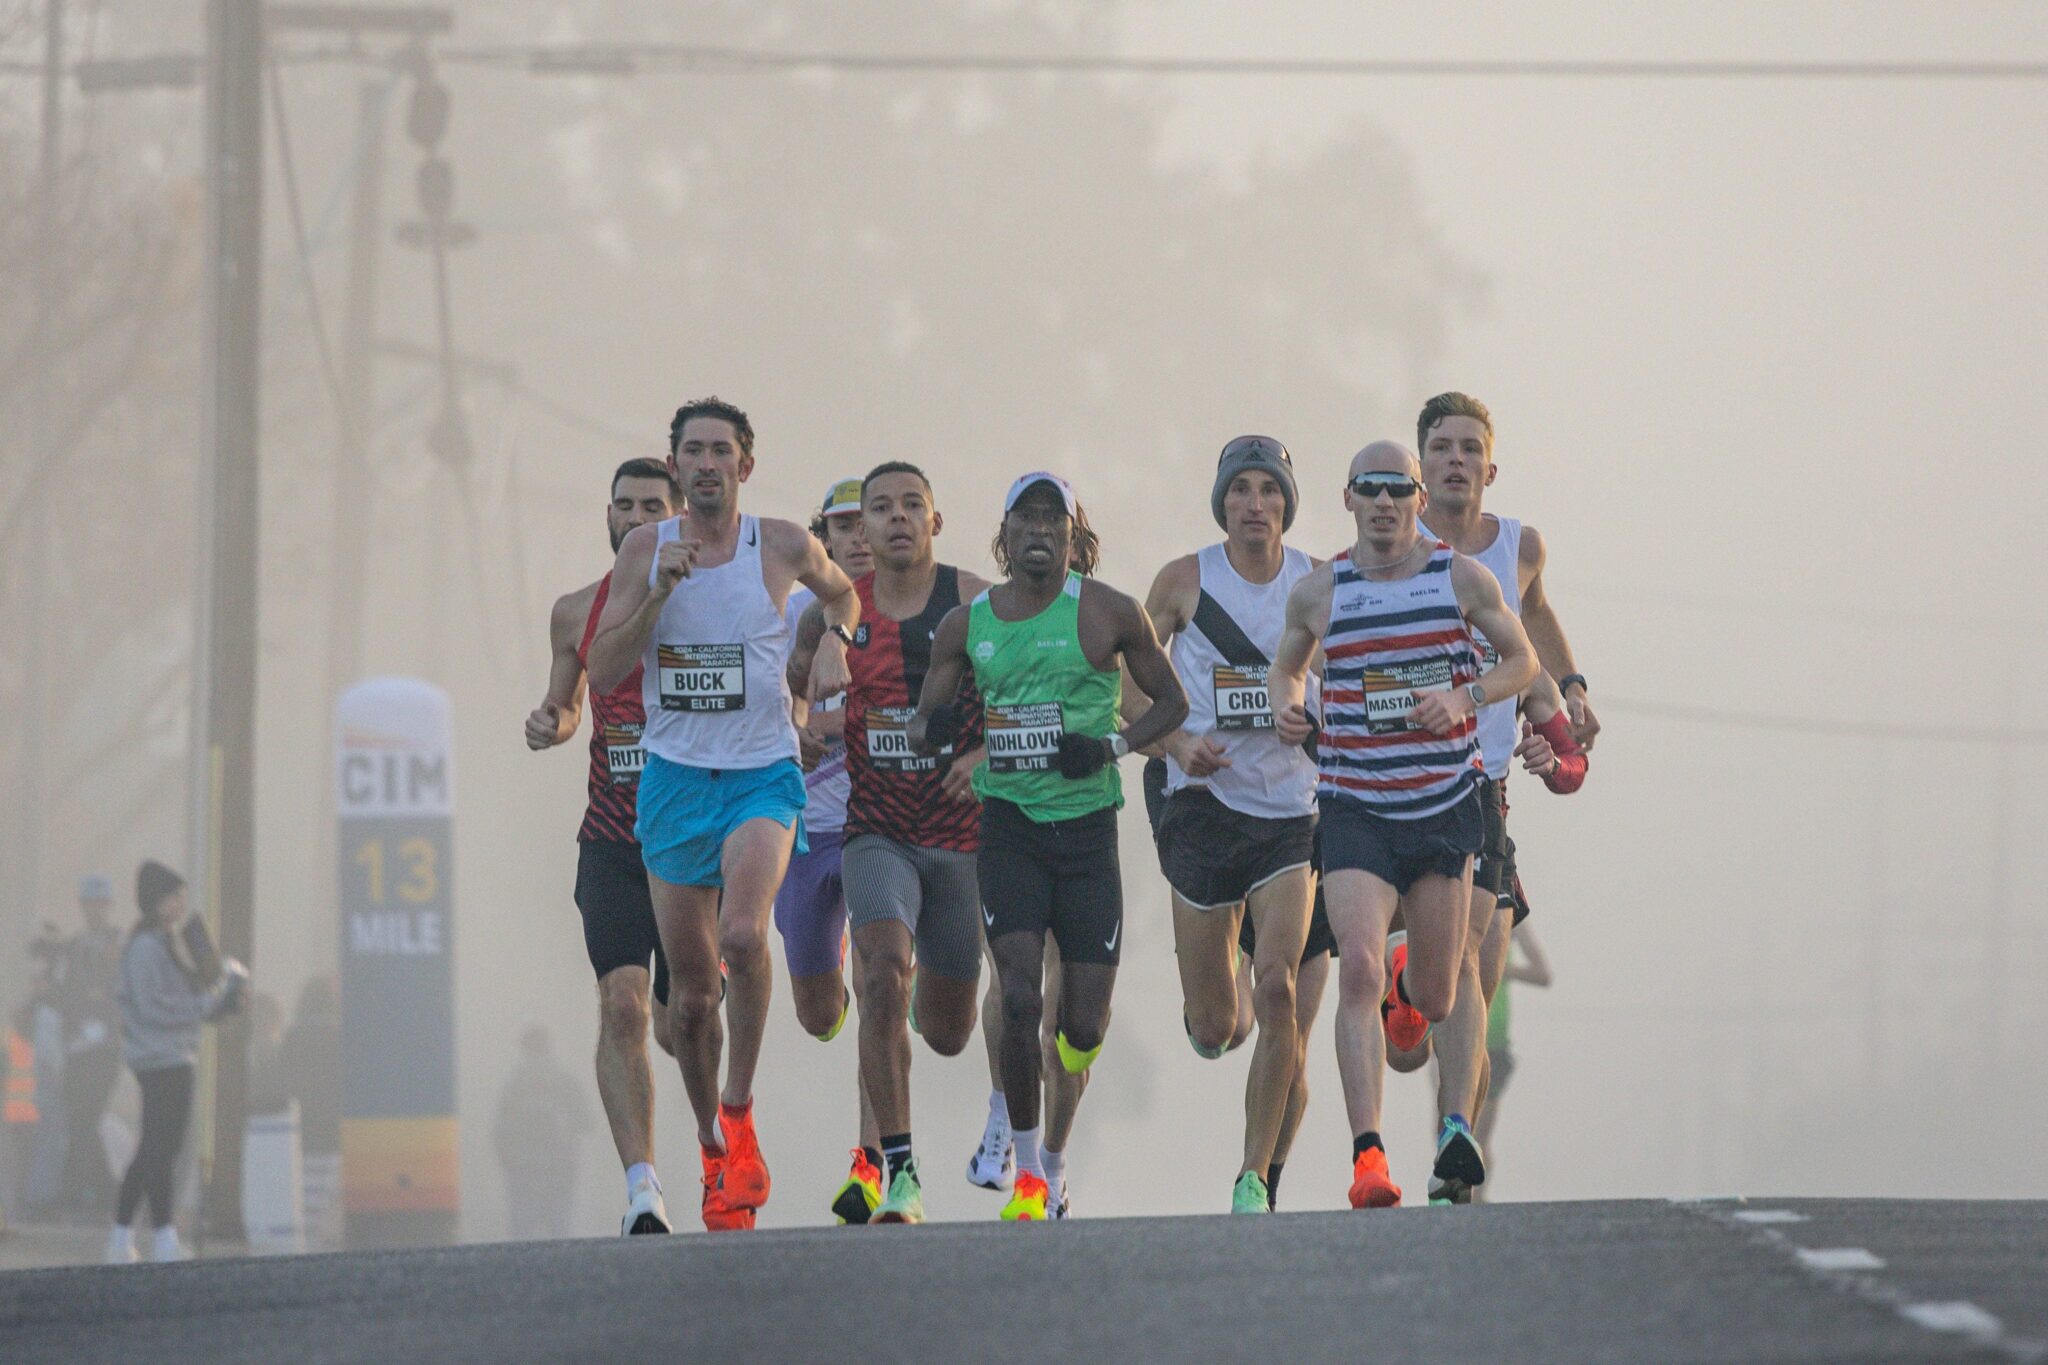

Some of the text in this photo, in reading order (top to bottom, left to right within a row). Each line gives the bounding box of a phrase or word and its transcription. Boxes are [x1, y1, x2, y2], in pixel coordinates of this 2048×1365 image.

[673, 645, 741, 654] 2024 CALIFORNIA
[684, 652, 741, 660] INTERNATIONAL
[700, 659, 742, 667] MARATHON
[1408, 659, 1450, 672] CALIFORNIA
[1395, 667, 1450, 681] INTERNATIONAL
[1412, 675, 1452, 687] MARATHON
[674, 672, 726, 691] BUCK
[691, 697, 726, 710] ELITE
[1018, 702, 1060, 713] CALIFORNIA
[1228, 691, 1270, 710] CRO
[1007, 710, 1059, 721] INTERNATIONAL
[1020, 717, 1061, 728] MARATHON
[872, 734, 907, 753] JOR
[989, 730, 1063, 752] NDHLOVU
[901, 757, 936, 771] ELITE
[1015, 756, 1049, 771] ELITE
[342, 754, 446, 805] CIM
[356, 836, 439, 903] 13
[350, 910, 443, 955] MILE
